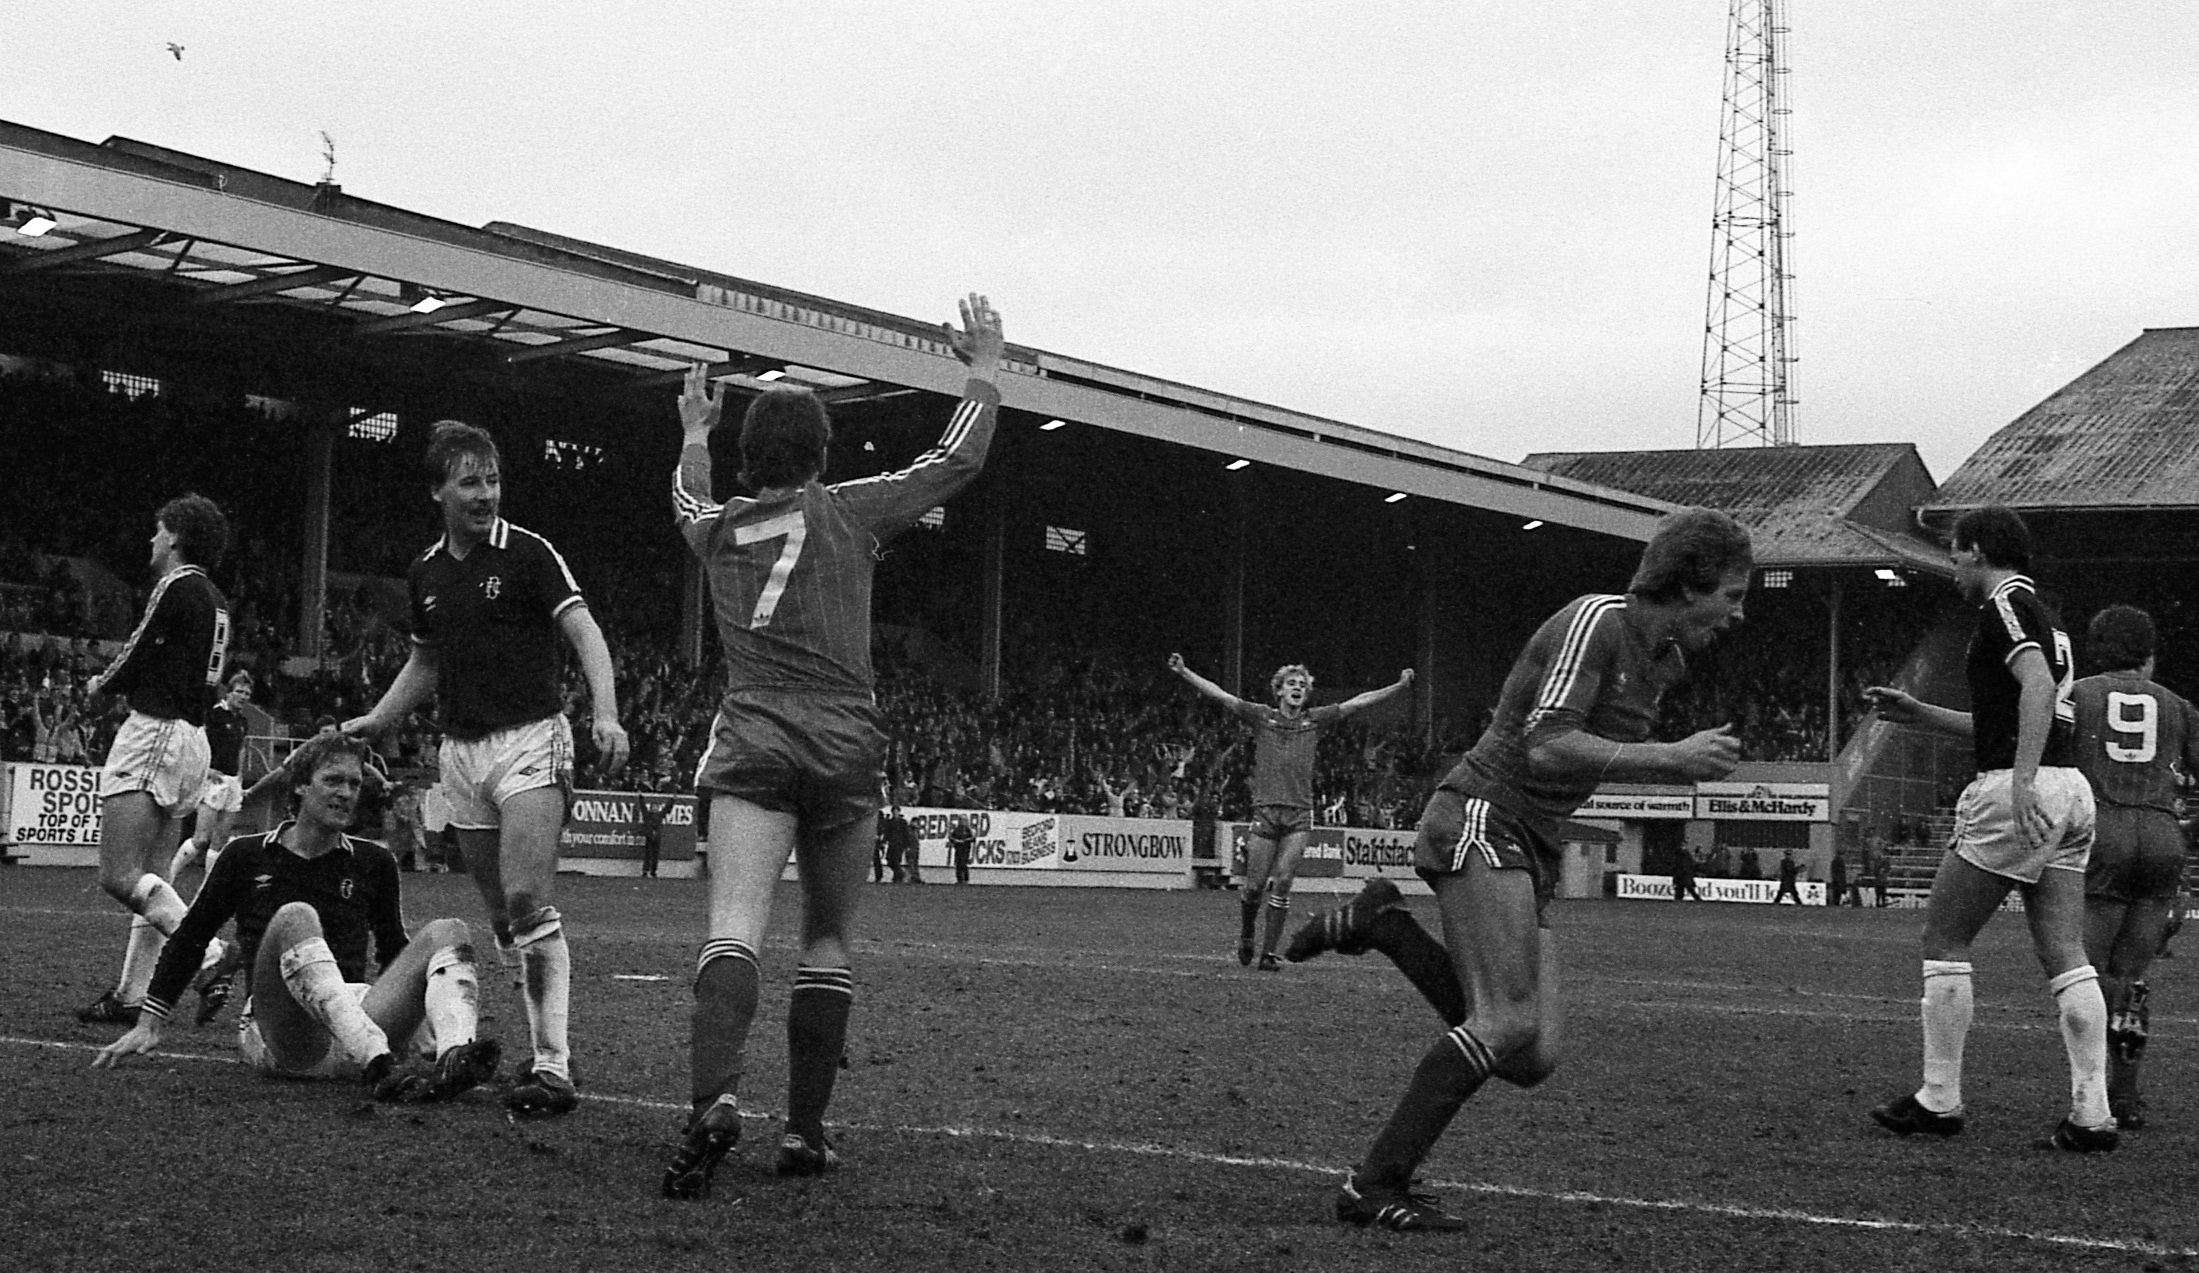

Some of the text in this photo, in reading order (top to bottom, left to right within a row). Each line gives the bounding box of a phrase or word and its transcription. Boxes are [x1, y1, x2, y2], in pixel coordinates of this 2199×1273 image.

[734, 510, 807, 629] 7
[2053, 628, 2076, 723] 2
[2105, 691, 2158, 763] 9
[43, 791, 103, 814] SPOR
[570, 800, 635, 823] ONNAN
[1595, 801, 1632, 811] source
[1633, 800, 1647, 811] of
[1647, 801, 1691, 812] warmth
[39, 814, 102, 828] TOP OF T
[918, 813, 990, 840] BEDFRD
[16, 827, 100, 842] SPORTS LE
[572, 833, 593, 848] your
[593, 830, 627, 845] comfort
[1082, 832, 1186, 859] STRONGBOW
[1346, 836, 1417, 873] Stakisfac
[1715, 883, 1760, 900] you'll
